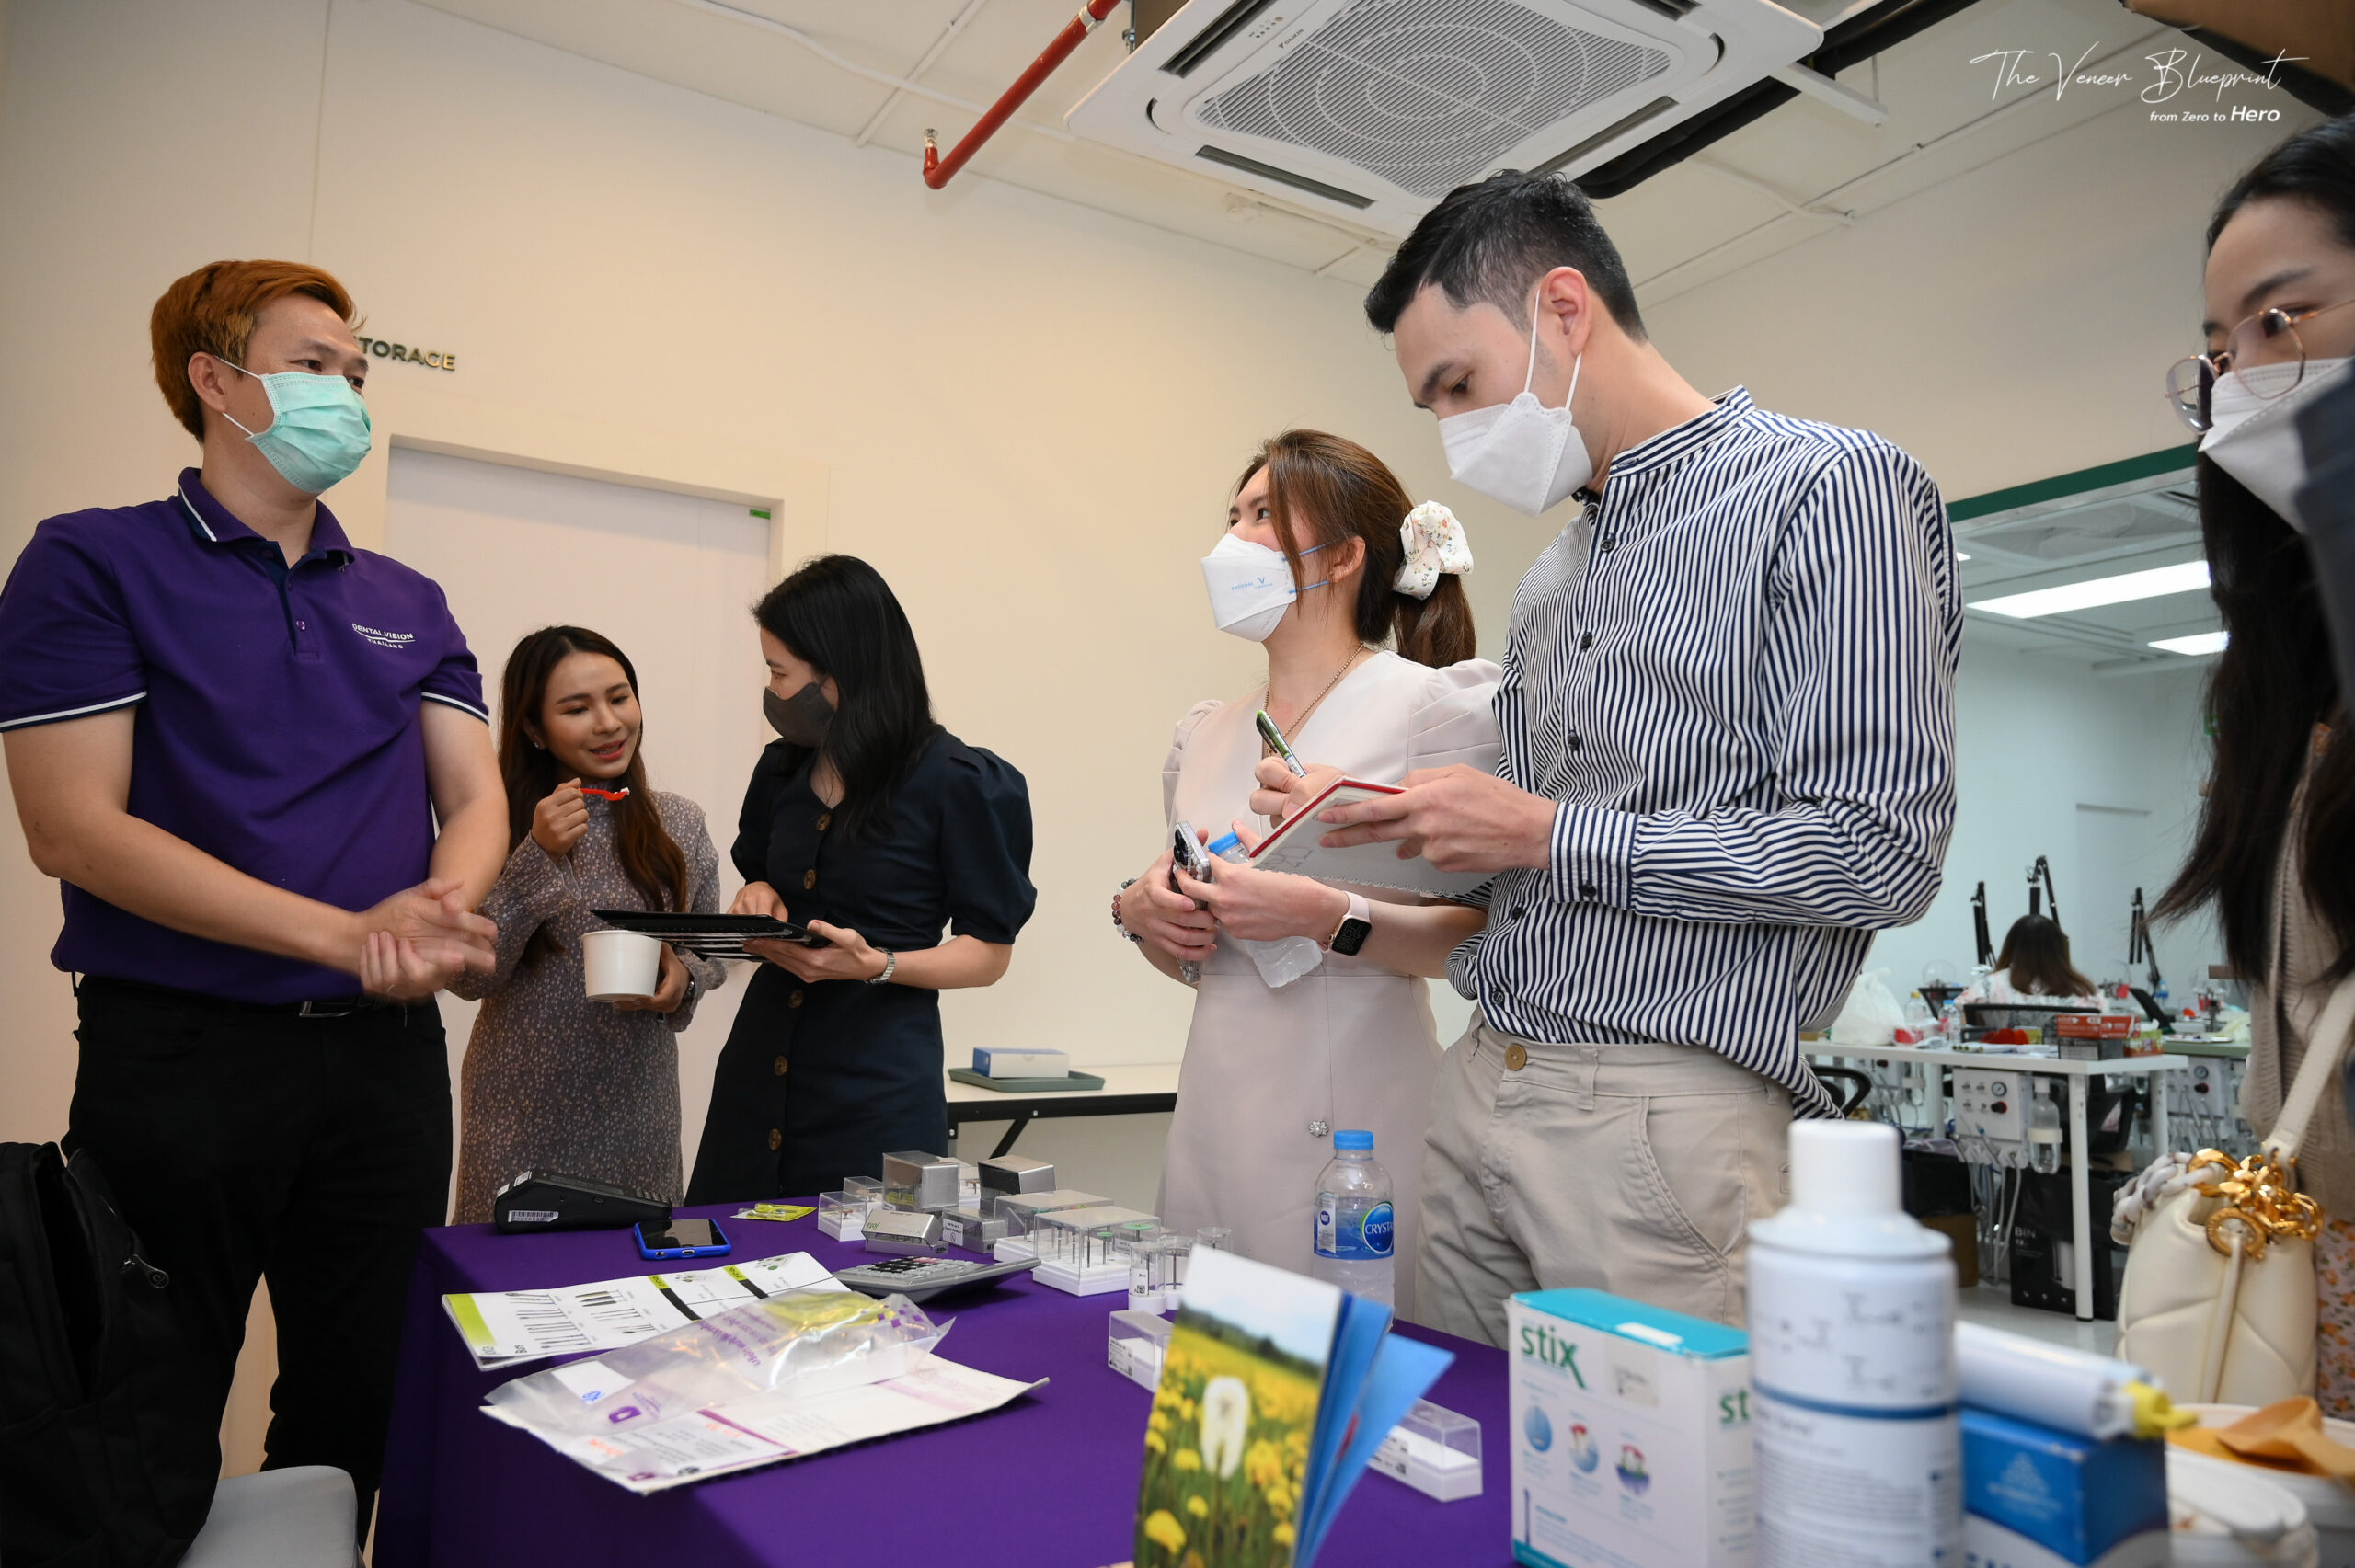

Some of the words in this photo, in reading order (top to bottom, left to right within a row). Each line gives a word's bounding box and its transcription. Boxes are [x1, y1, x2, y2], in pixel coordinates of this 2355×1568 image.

[353, 336, 456, 371] TORAGE
[1365, 1222, 1393, 1235] CRYST
[1522, 1325, 1585, 1389] stix
